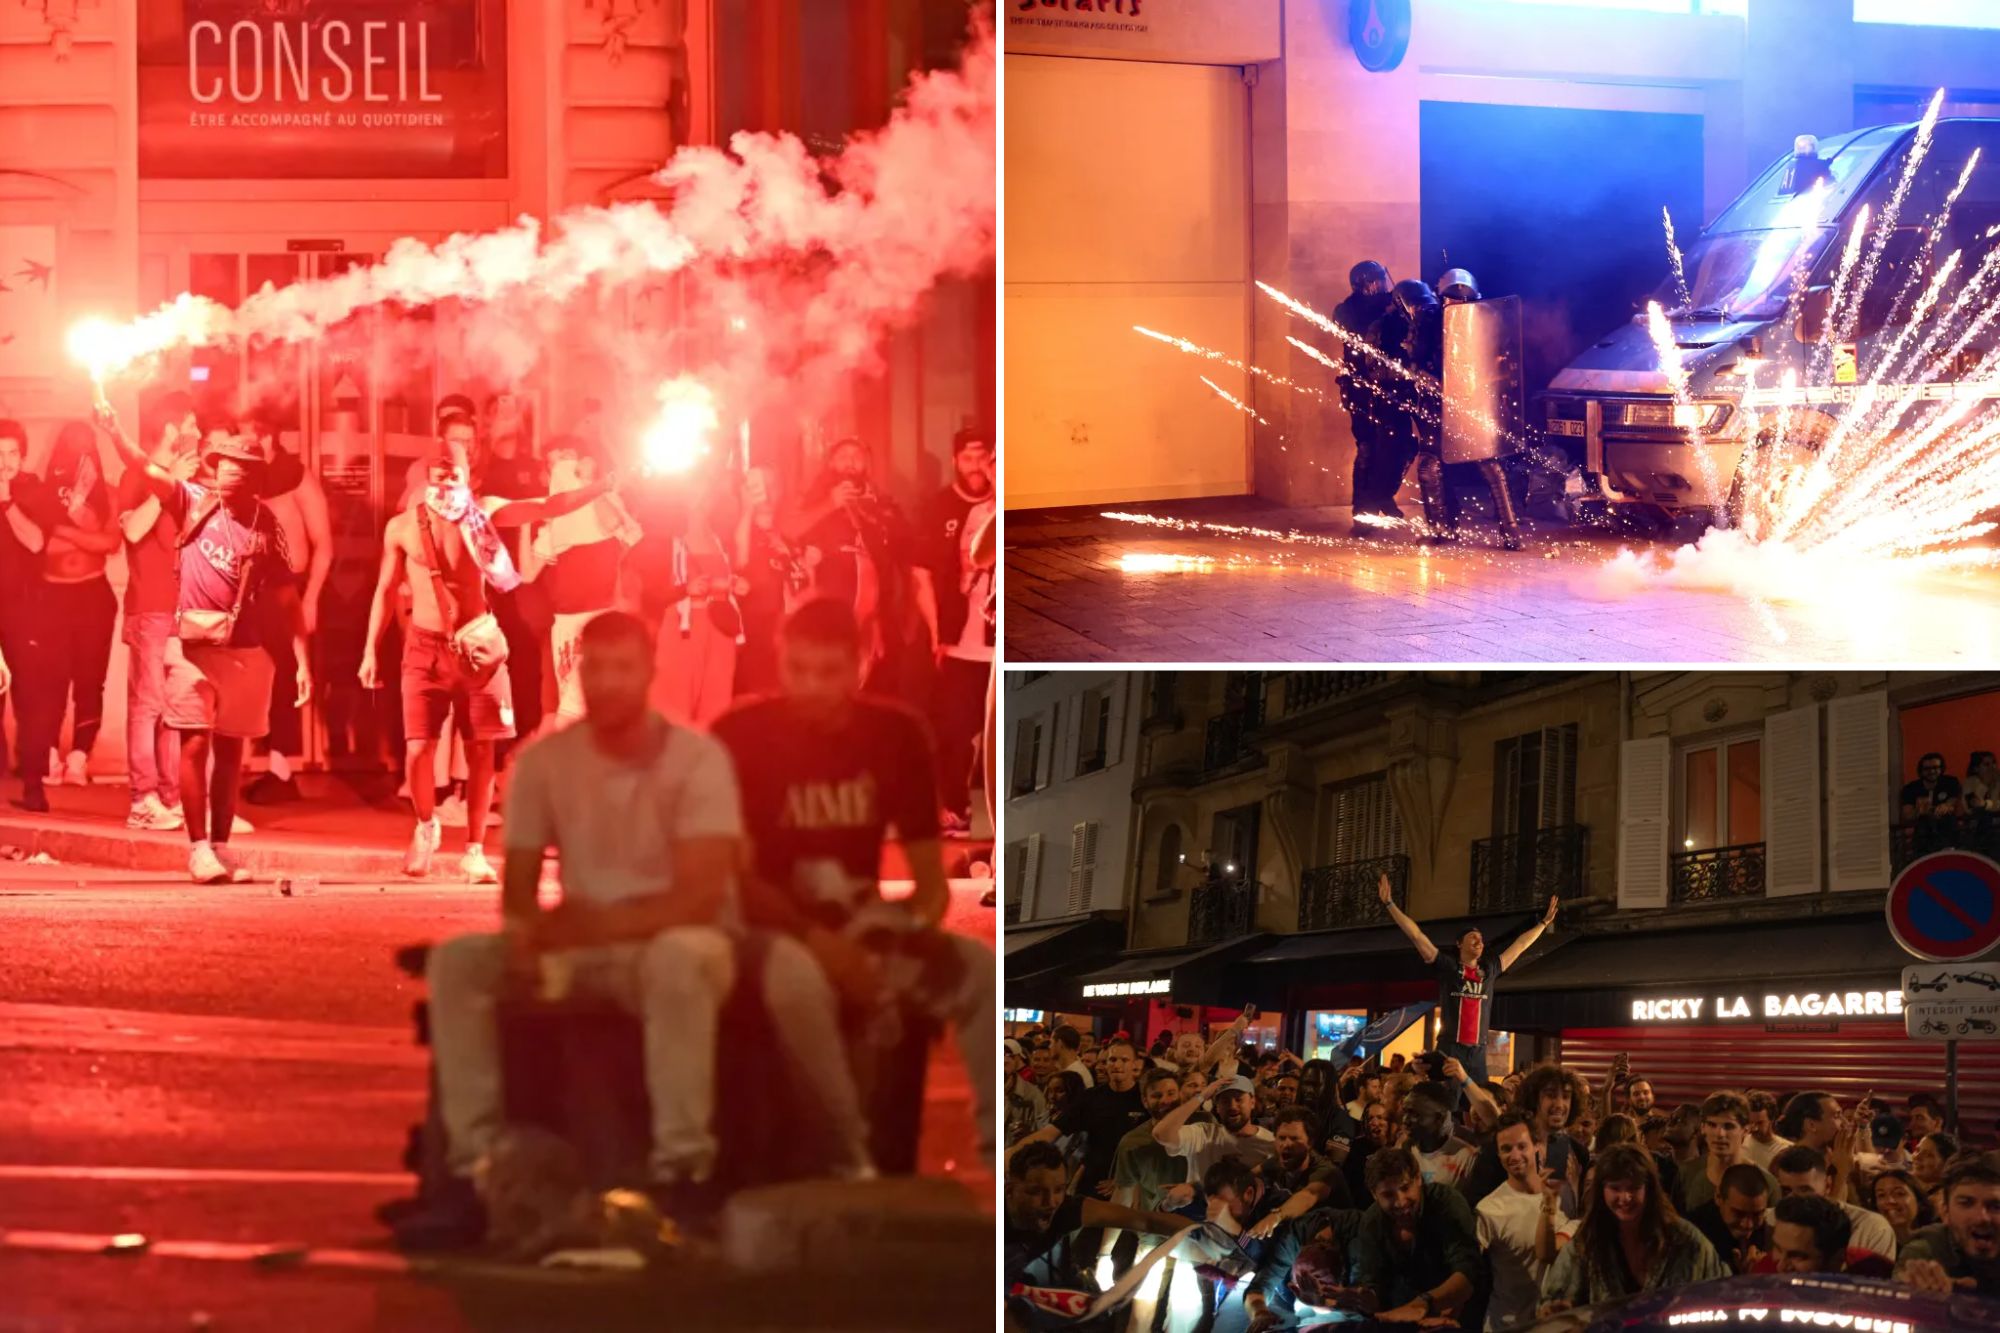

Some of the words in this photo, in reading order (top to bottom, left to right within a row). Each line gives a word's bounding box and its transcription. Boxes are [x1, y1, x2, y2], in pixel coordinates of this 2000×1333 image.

[189, 20, 442, 103] CONSEIL
[190, 111, 225, 127] ÊTRE
[231, 110, 331, 127] ACCOMPAGNÉ
[337, 113, 357, 126] AU
[362, 113, 443, 128] QUOTIDIEN
[1632, 998, 1703, 1020] RICKY
[1716, 997, 1751, 1018] LA
[1764, 990, 1903, 1016] BAGARRE
[1915, 1006, 1963, 1015] INTERDIT
